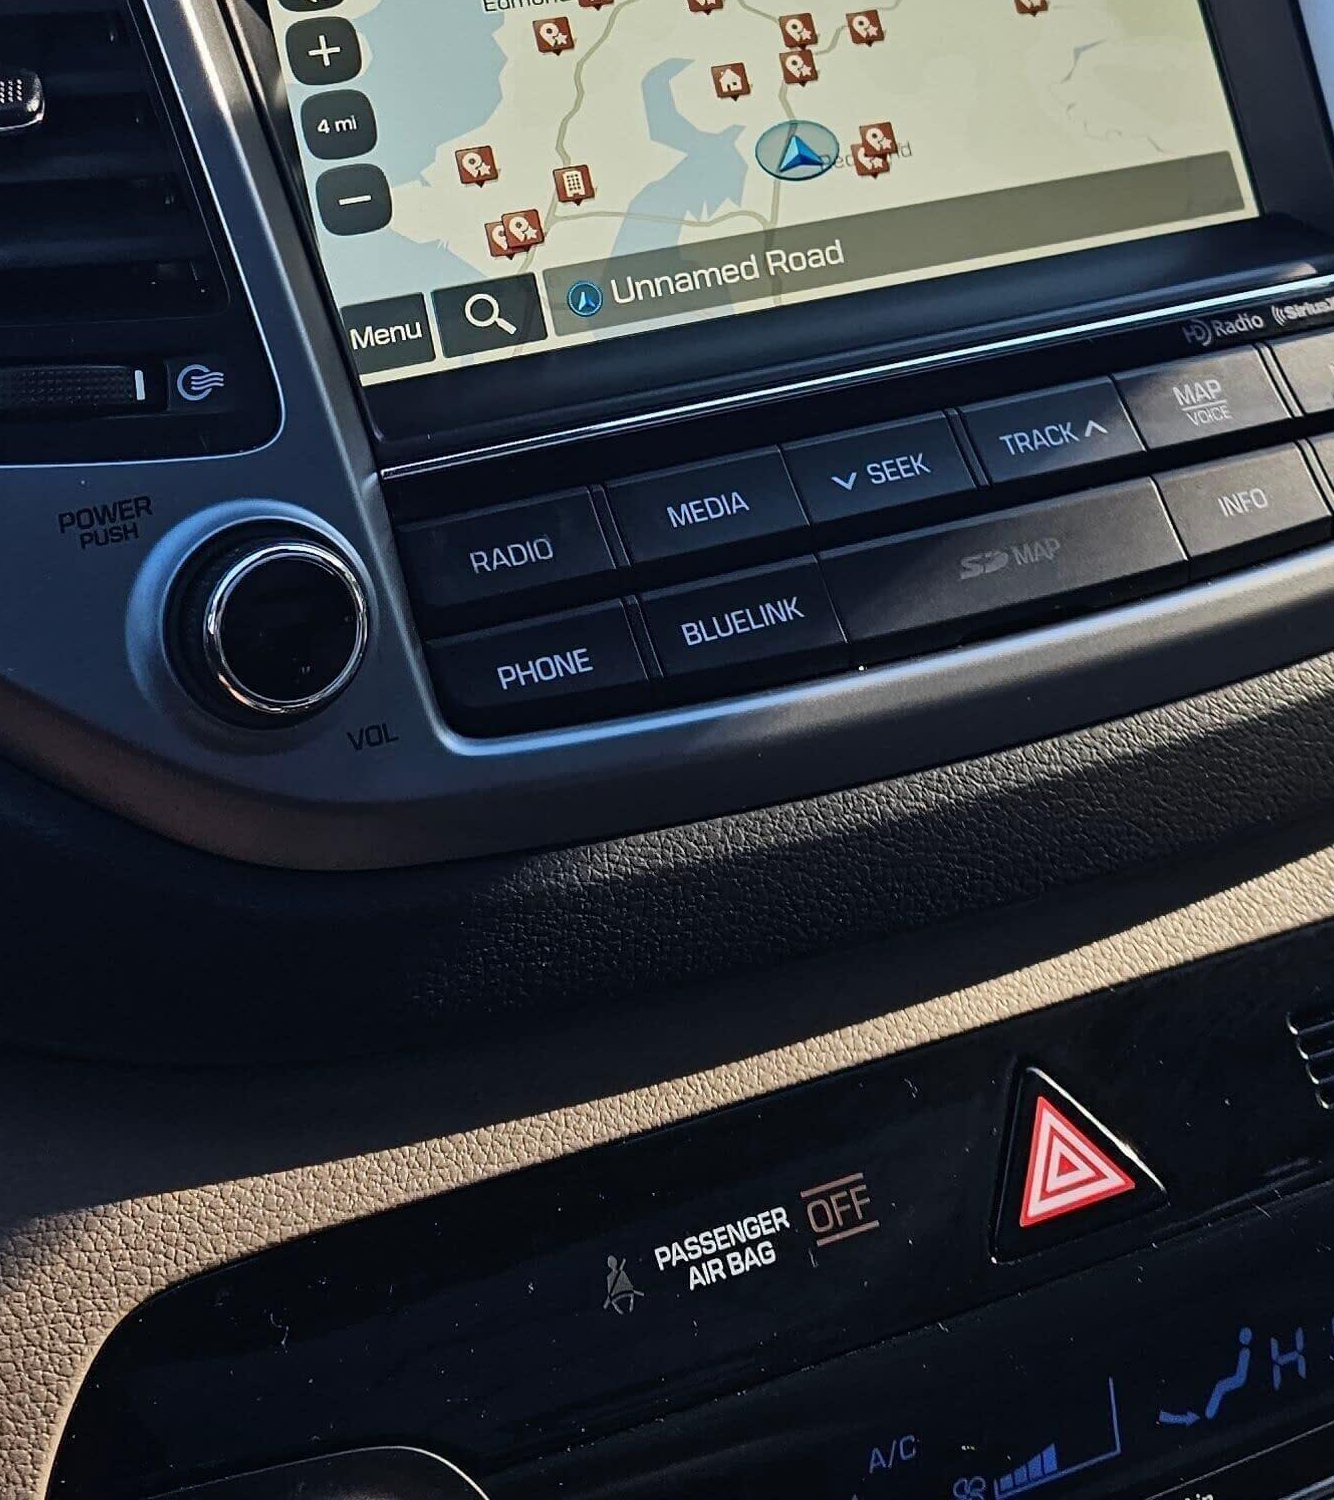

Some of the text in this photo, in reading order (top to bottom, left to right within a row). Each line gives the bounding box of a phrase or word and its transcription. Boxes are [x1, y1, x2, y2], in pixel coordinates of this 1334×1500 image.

[317, 115, 357, 134] 4 mi
[610, 240, 845, 305] Unnamed Road
[350, 321, 423, 350] Menu
[1214, 312, 1265, 339] Radio
[1172, 379, 1222, 406] MAP
[1186, 405, 1233, 426] VOICE
[999, 421, 1079, 457] TRACK
[867, 453, 931, 486] SEEK
[57, 496, 154, 534] POWER
[667, 490, 750, 528] MEDIA
[1218, 488, 1268, 517] INFO
[79, 522, 140, 550] PUSH
[1011, 538, 1061, 566] MAP
[469, 537, 554, 574] RADIO
[681, 596, 805, 646] BLUELINK
[496, 647, 594, 690] PHONE
[347, 723, 400, 751] VOL
[654, 1184, 871, 1271] PASSENGER OFF
[689, 1241, 776, 1291] AIR BAG
[868, 1434, 919, 1475] A/C
